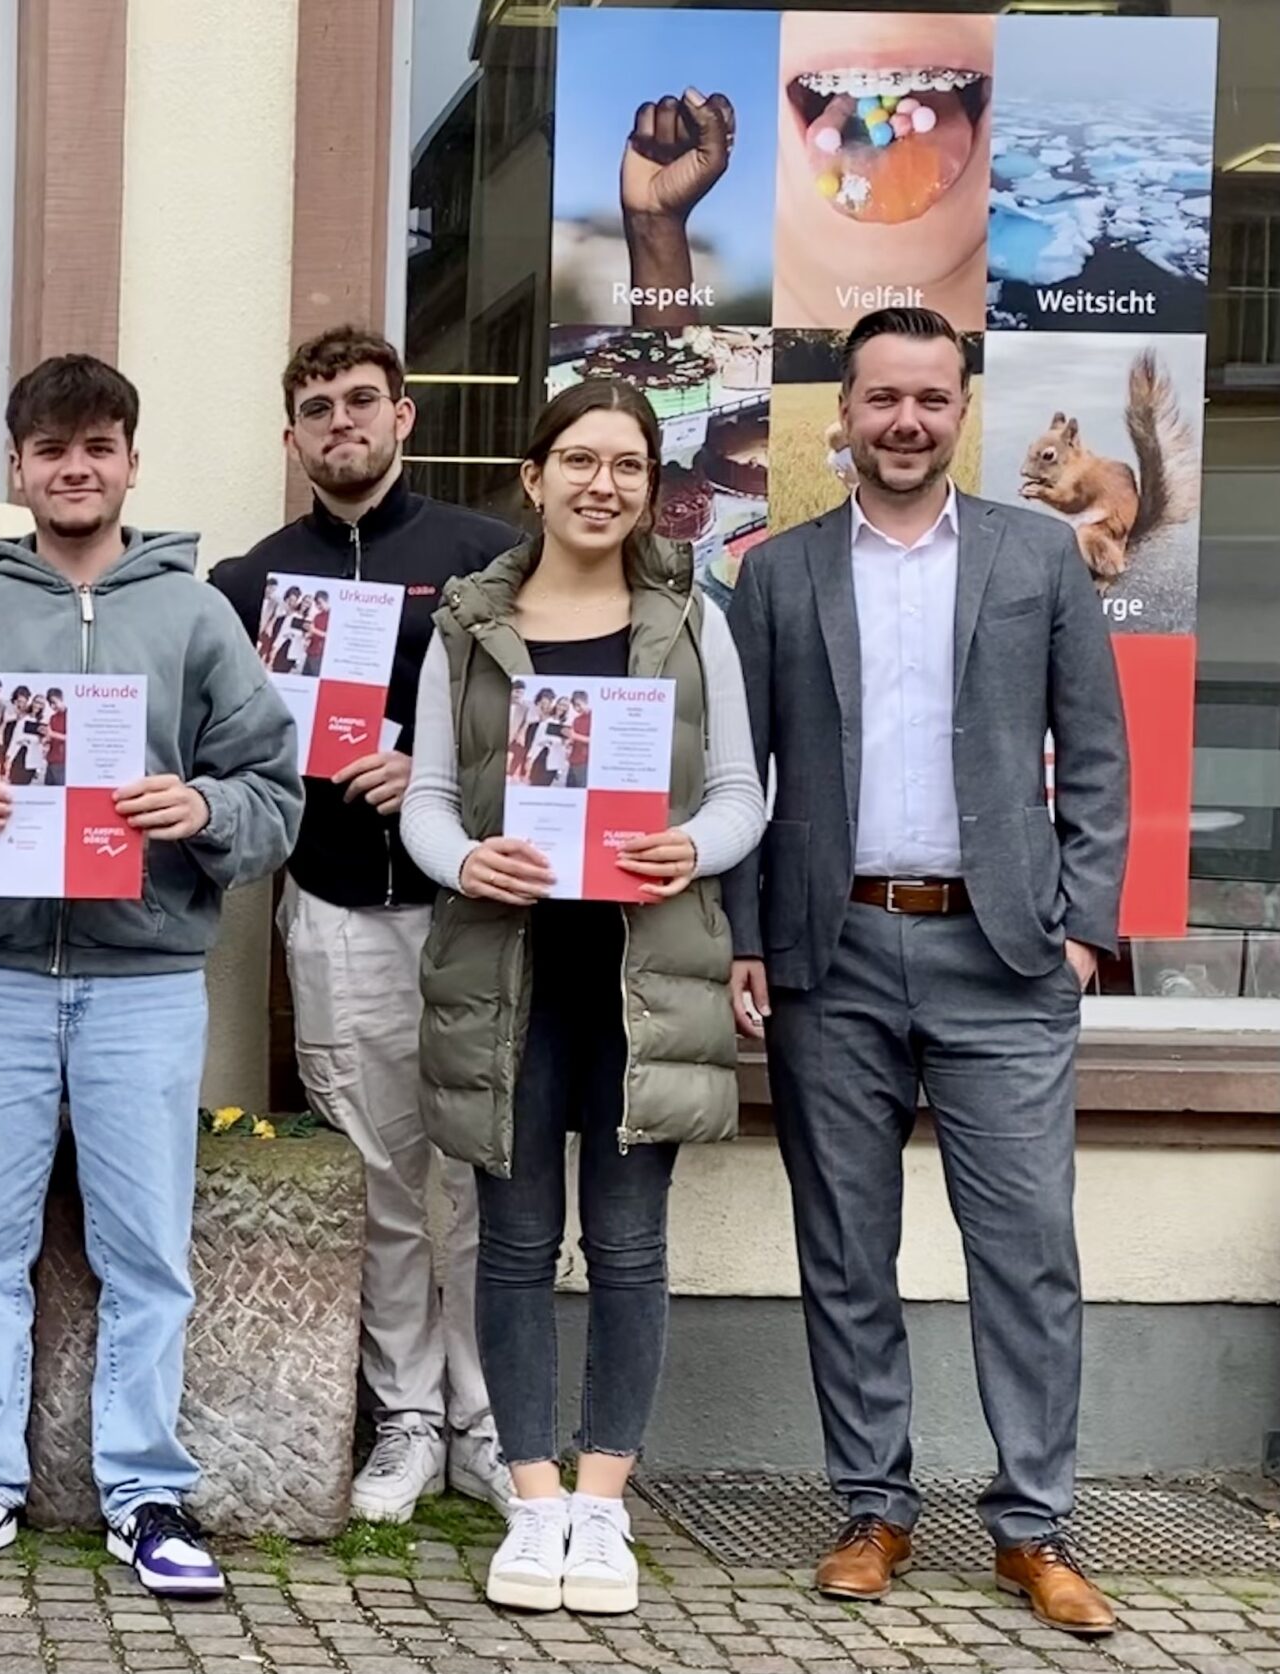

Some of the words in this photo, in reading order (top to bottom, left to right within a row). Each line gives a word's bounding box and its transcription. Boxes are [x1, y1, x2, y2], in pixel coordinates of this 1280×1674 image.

[612, 281, 715, 312] Respekt
[835, 285, 924, 308] Vielfalt
[1037, 288, 1156, 314] Weitsicht
[339, 589, 395, 606] Urkunde
[1102, 598, 1143, 621] rge
[75, 684, 138, 699] Urkunde
[600, 687, 666, 703] Urkunde
